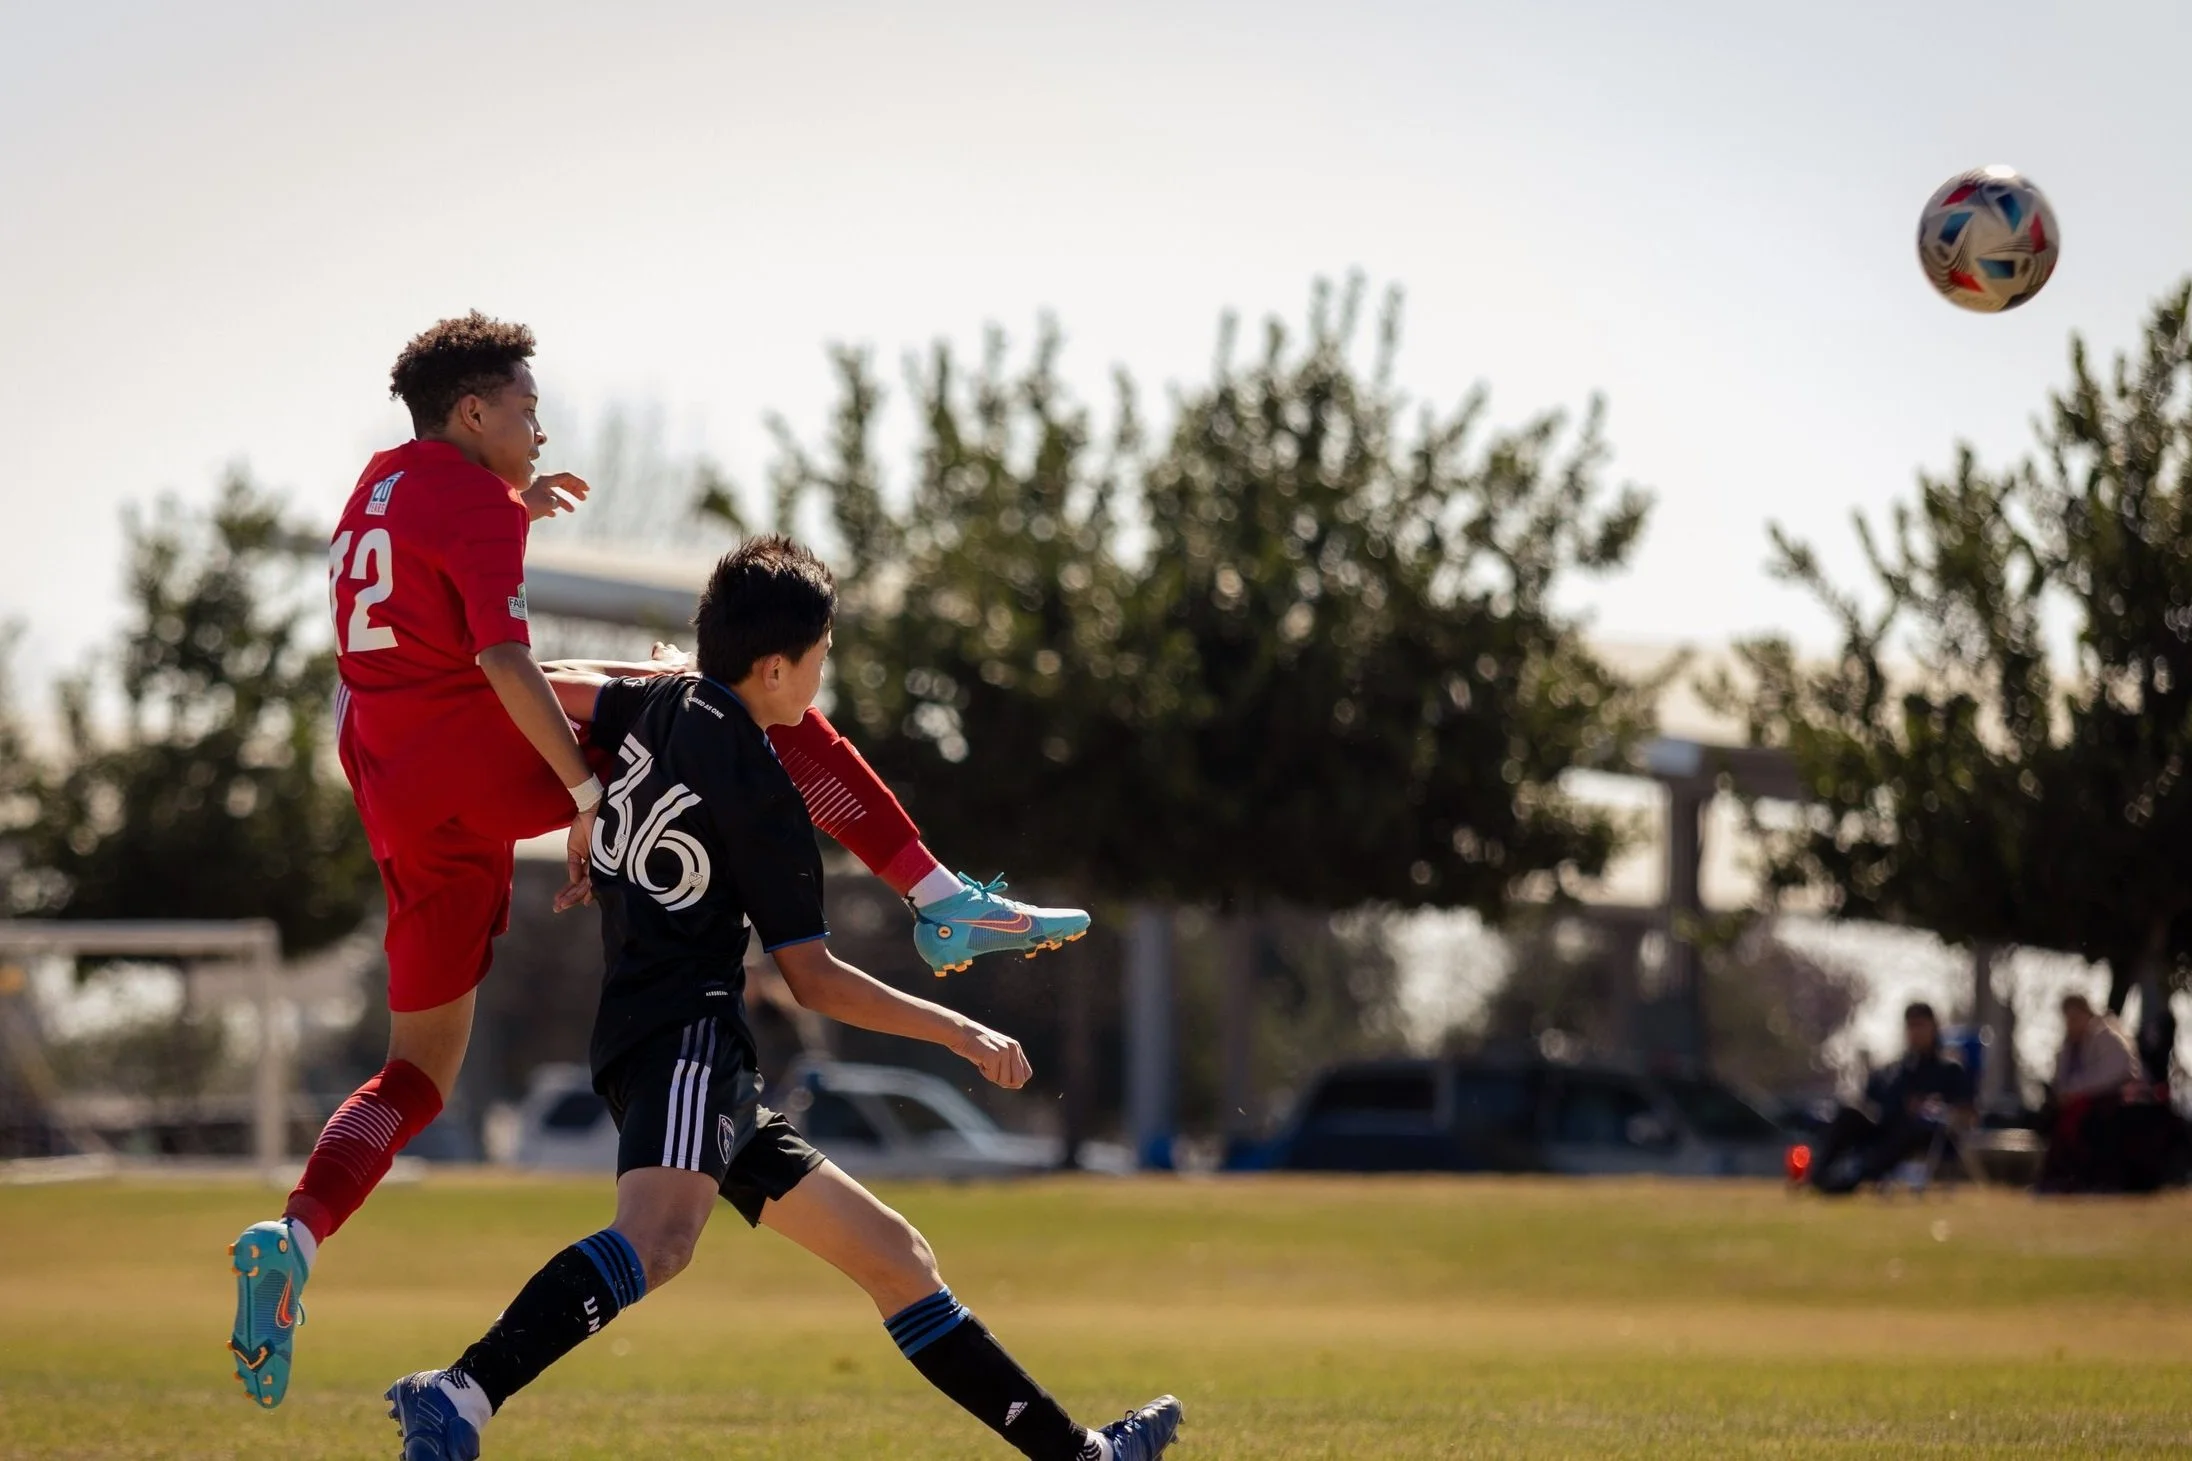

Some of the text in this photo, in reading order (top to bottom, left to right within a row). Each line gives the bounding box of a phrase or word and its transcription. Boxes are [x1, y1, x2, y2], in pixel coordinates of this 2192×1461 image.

[372, 479, 394, 502] 20
[711, 707, 725, 720] ONE
[590, 732, 711, 912] 36
[1005, 1401, 1028, 1426] adidas
